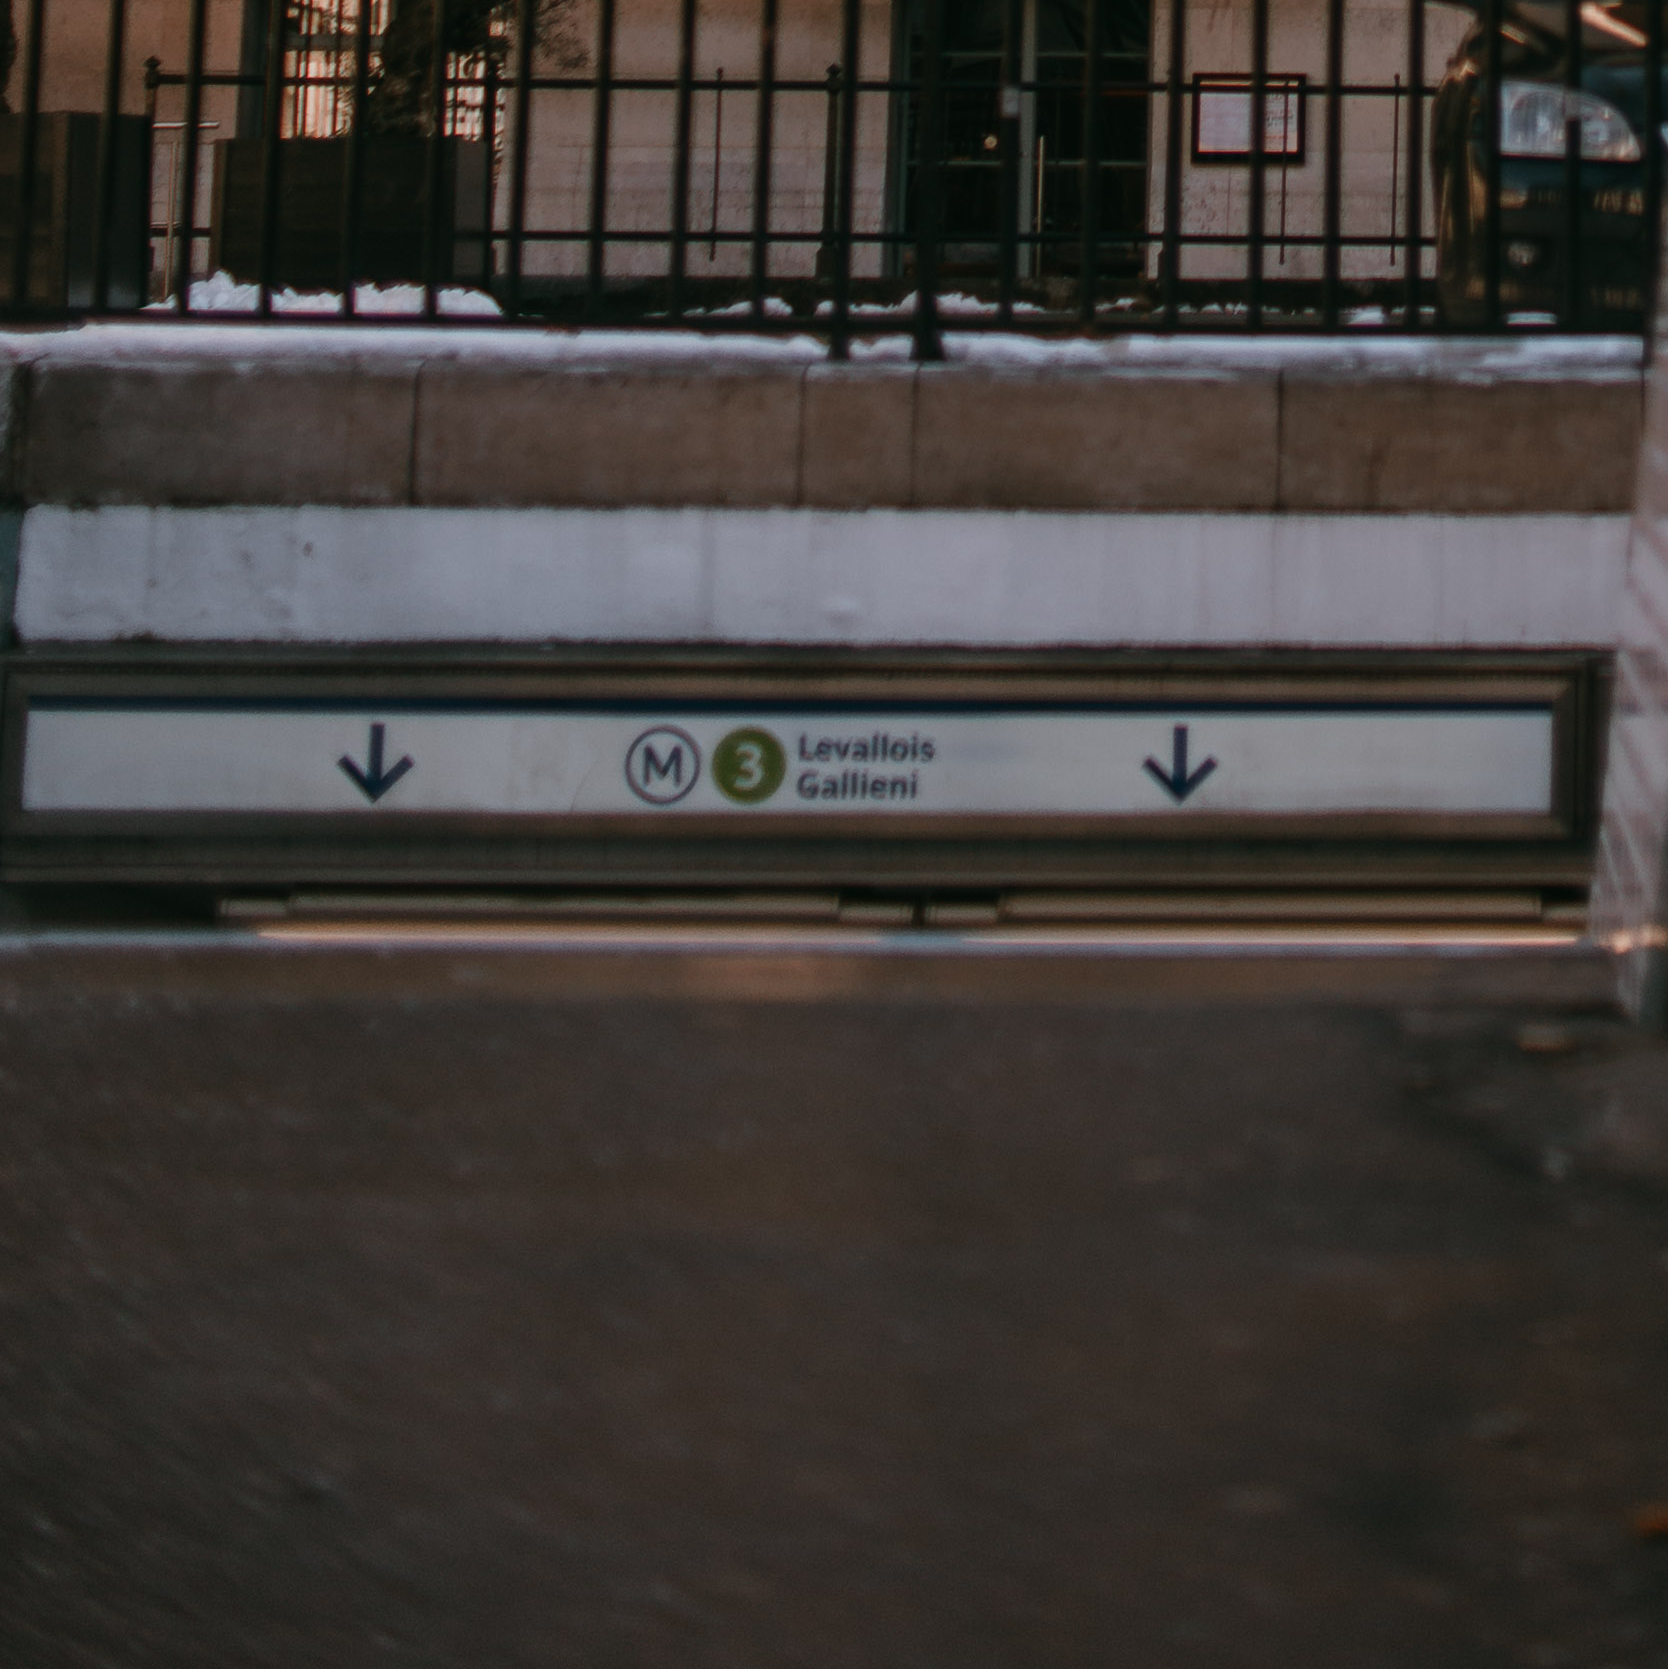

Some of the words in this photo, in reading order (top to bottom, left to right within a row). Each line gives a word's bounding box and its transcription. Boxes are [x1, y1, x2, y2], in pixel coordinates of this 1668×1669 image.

[798, 732, 935, 762] Levallois
[642, 744, 683, 788] M
[732, 741, 764, 790] 3
[796, 769, 919, 800] Gallieni
